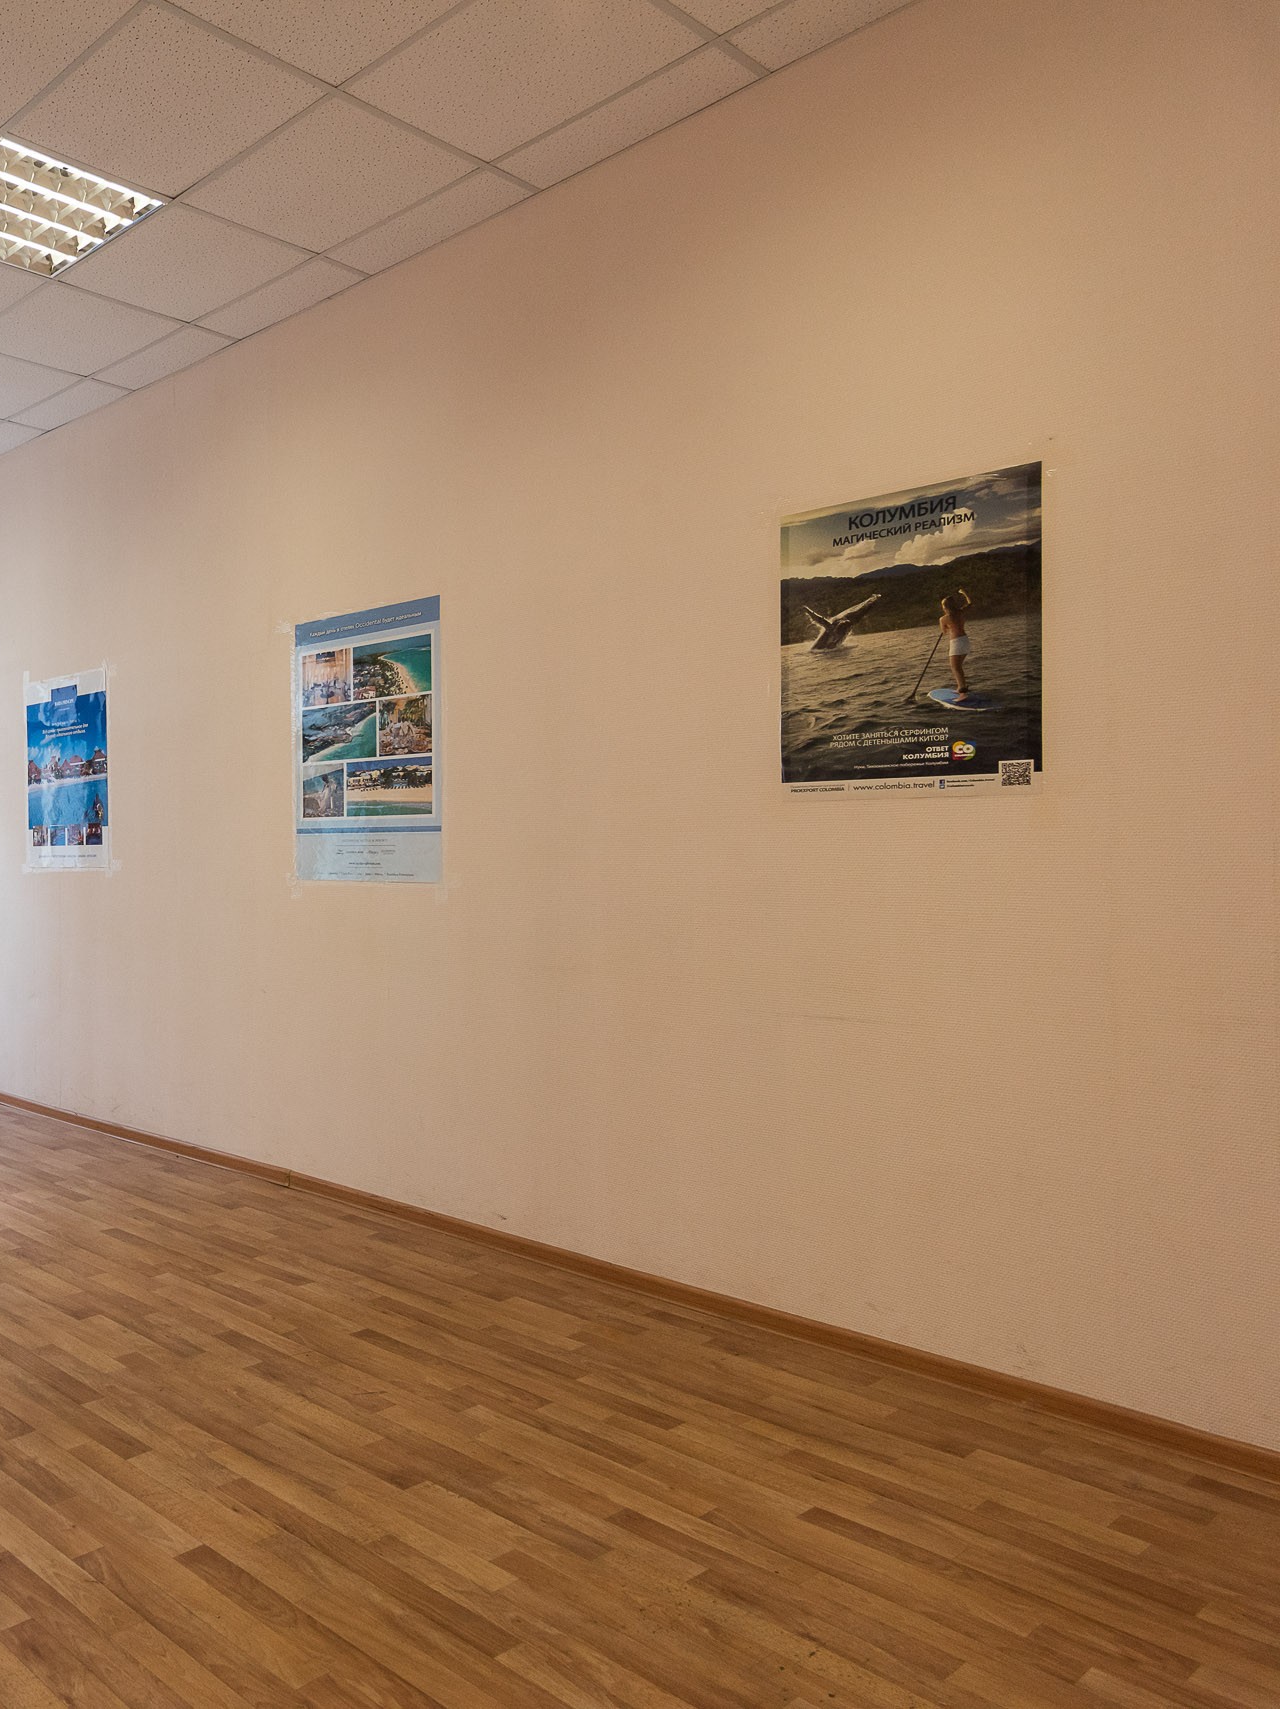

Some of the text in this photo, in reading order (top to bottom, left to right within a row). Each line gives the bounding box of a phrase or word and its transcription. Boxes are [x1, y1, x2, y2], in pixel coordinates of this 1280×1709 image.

[848, 495, 957, 530] КОЛУМБИЯ
[832, 511, 975, 547] МАГИЧЕСКИЙ РЕАЛИЗМ
[355, 618, 381, 629] Occidental
[832, 727, 949, 741] ХОТИТЕ ЗАНЯТЬСЯ СЕРФИНГОМ
[863, 737, 918, 746] ДЕТЕНЫШАМИ
[919, 734, 949, 742] КИТОВ?
[926, 745, 949, 753] ОТВЕТ
[902, 752, 950, 760] КОЛУМБИЯ
[853, 780, 935, 791] www.colombia.travel
